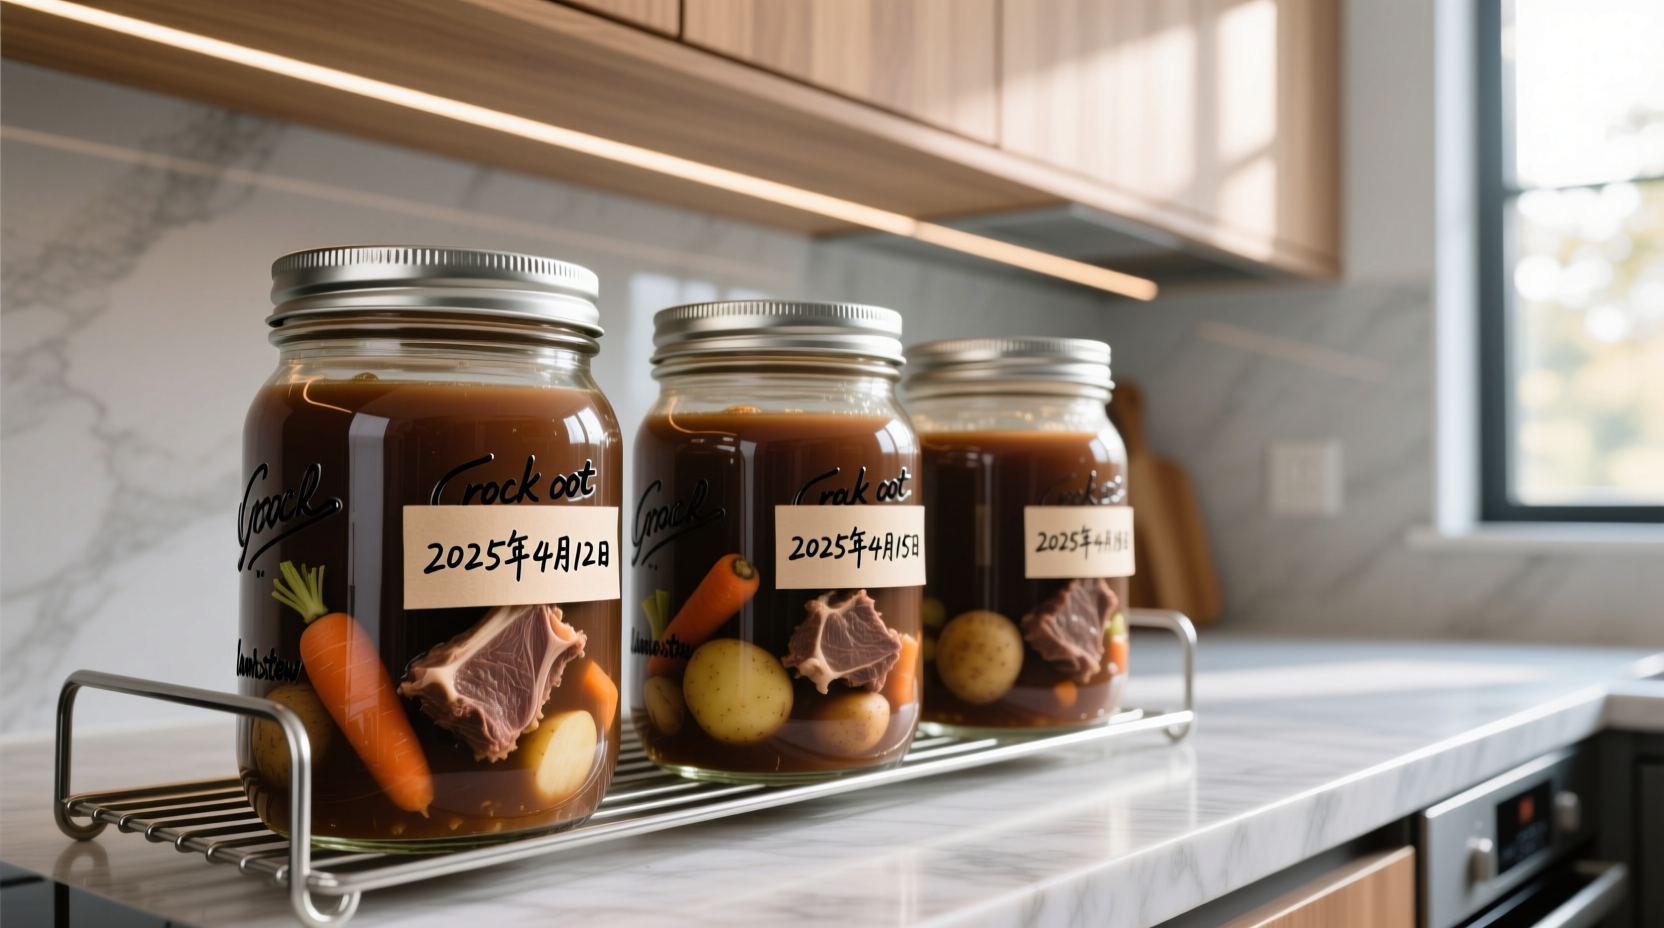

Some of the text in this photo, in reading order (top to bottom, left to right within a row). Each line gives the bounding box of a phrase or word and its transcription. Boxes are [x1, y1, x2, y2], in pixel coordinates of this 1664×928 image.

[424, 529, 610, 582] 2025年4月12日
[788, 526, 919, 569] 2025年4月15日
